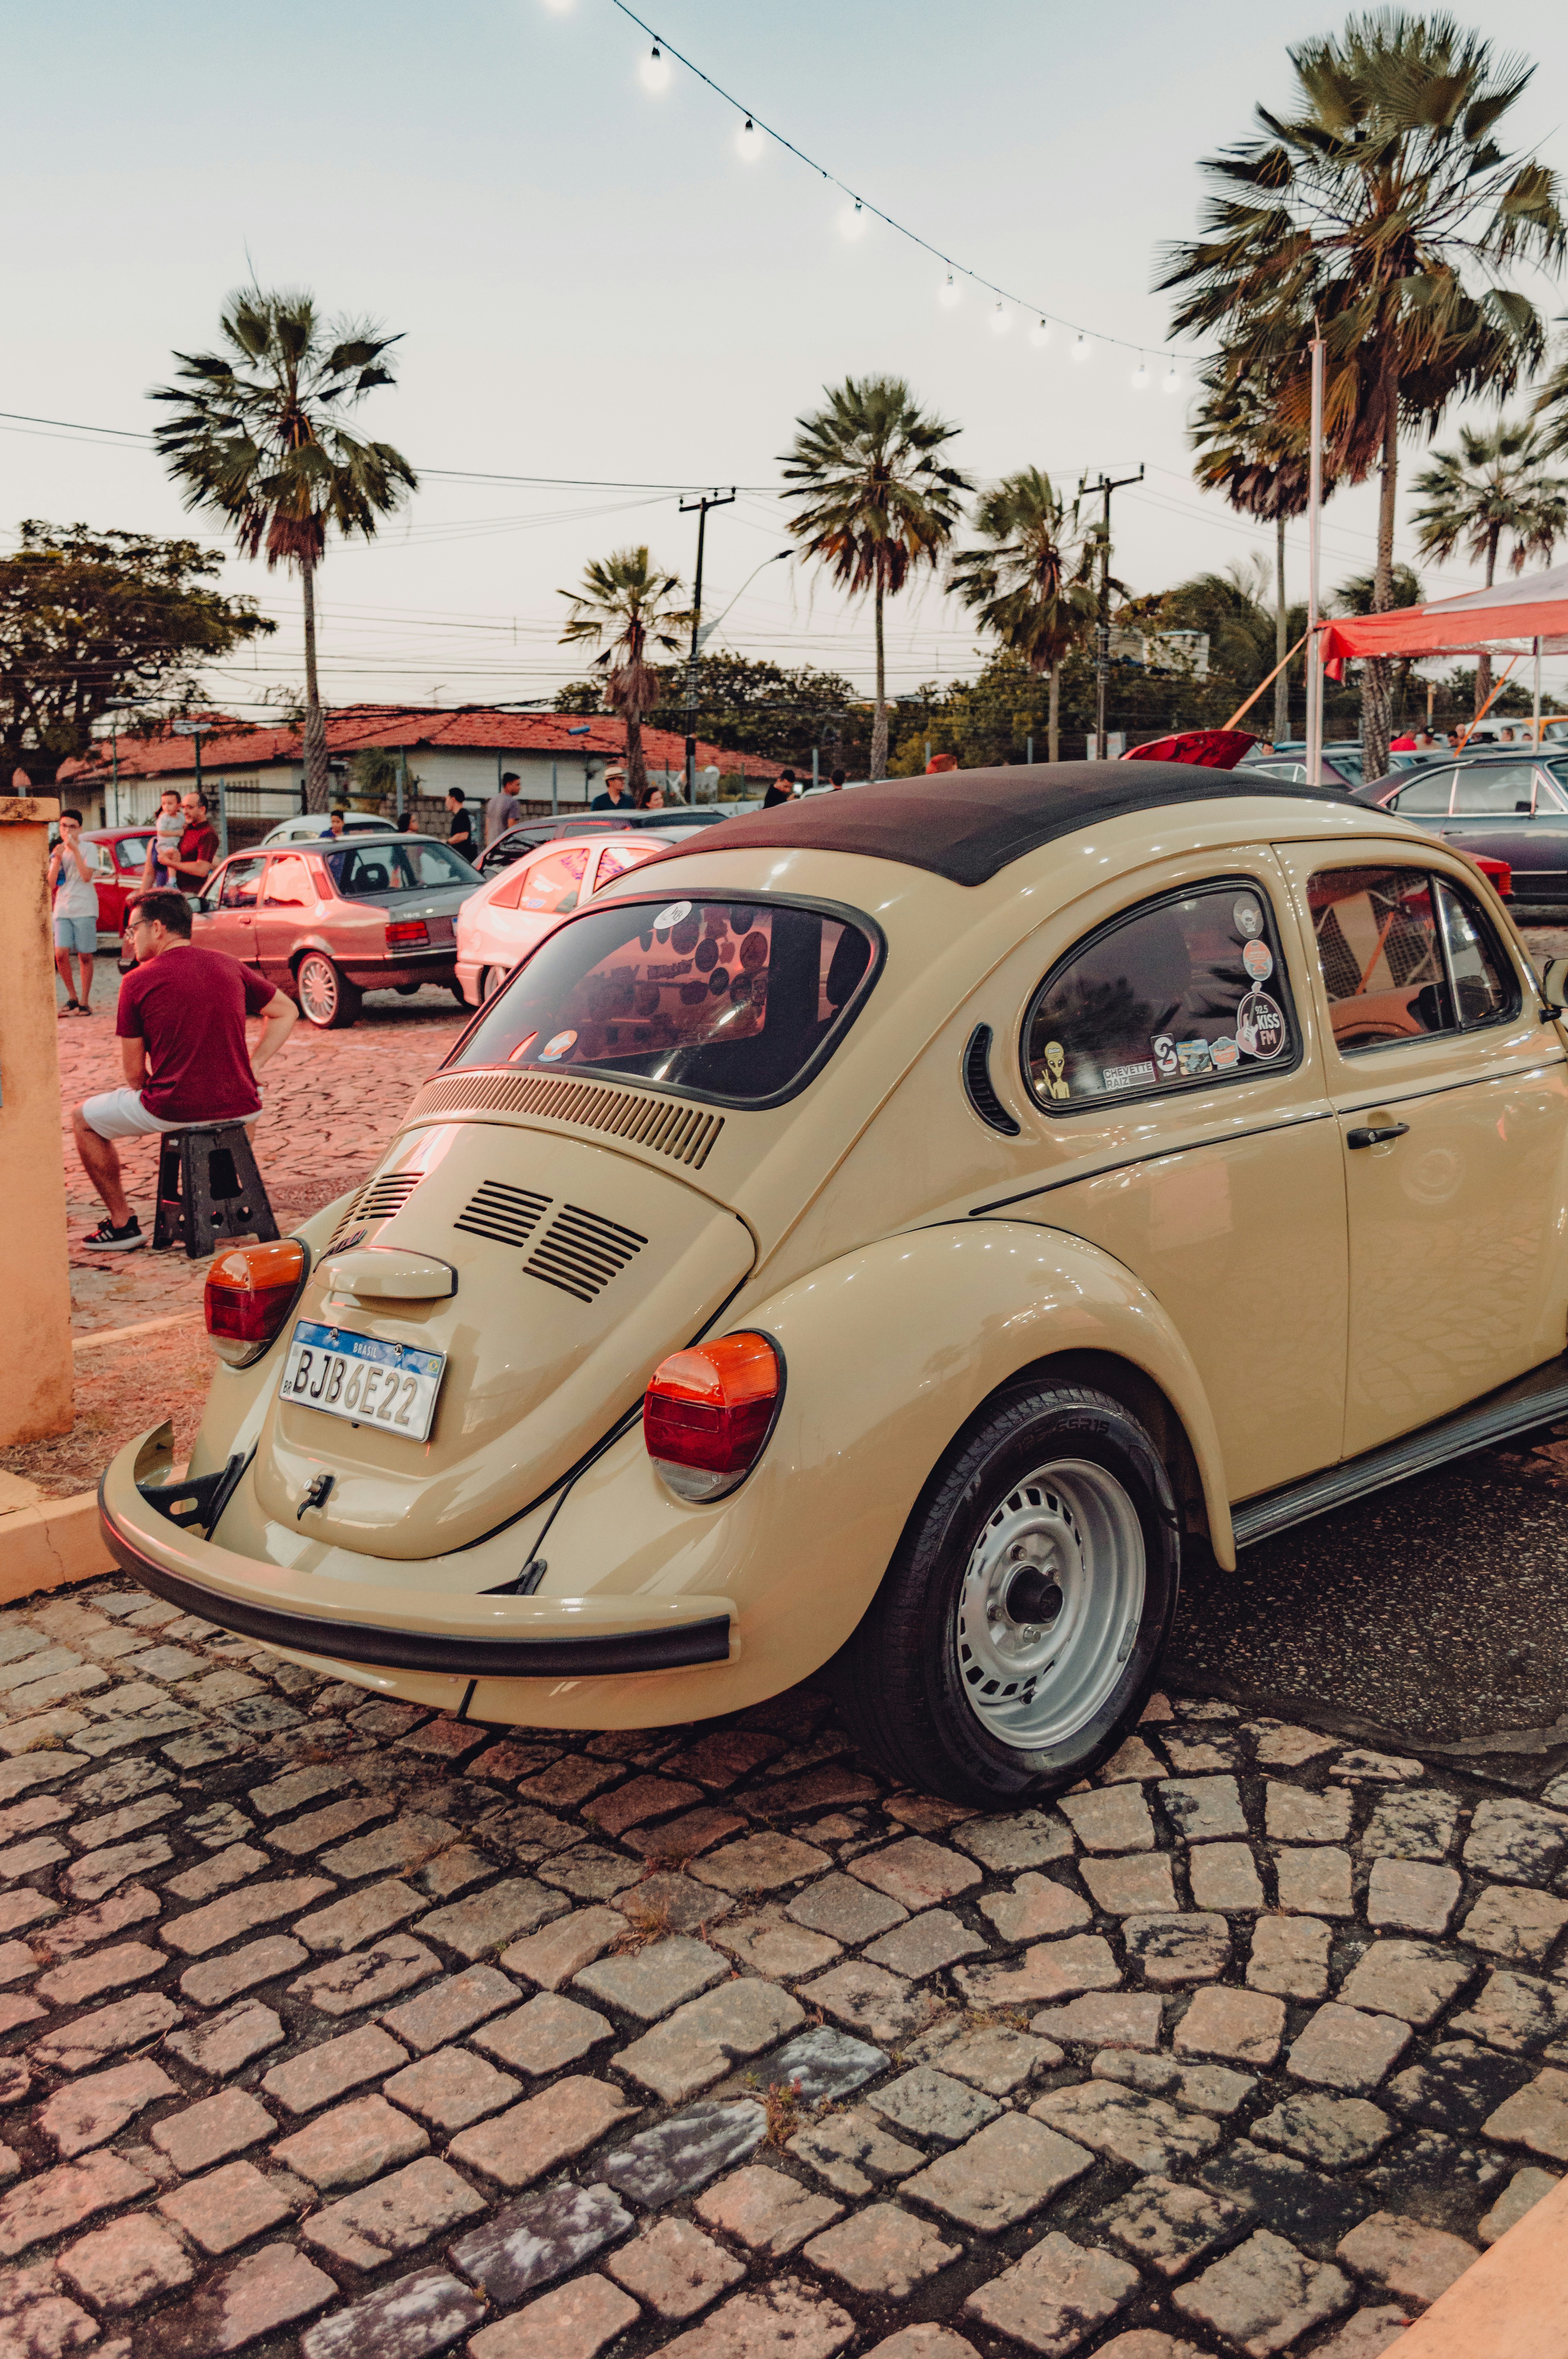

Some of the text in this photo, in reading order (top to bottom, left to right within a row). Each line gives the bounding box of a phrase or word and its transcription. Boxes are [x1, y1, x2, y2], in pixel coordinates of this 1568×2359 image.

[1256, 1013, 1280, 1030] KISS
[1260, 1030, 1276, 1045] FM
[1104, 1062, 1152, 1079] CHEVETTE
[1105, 1077, 1129, 1089] RAIZ
[352, 1342, 377, 1358] BRASIL
[283, 1380, 292, 1394] BR
[292, 1349, 418, 1425] BJB6E22
